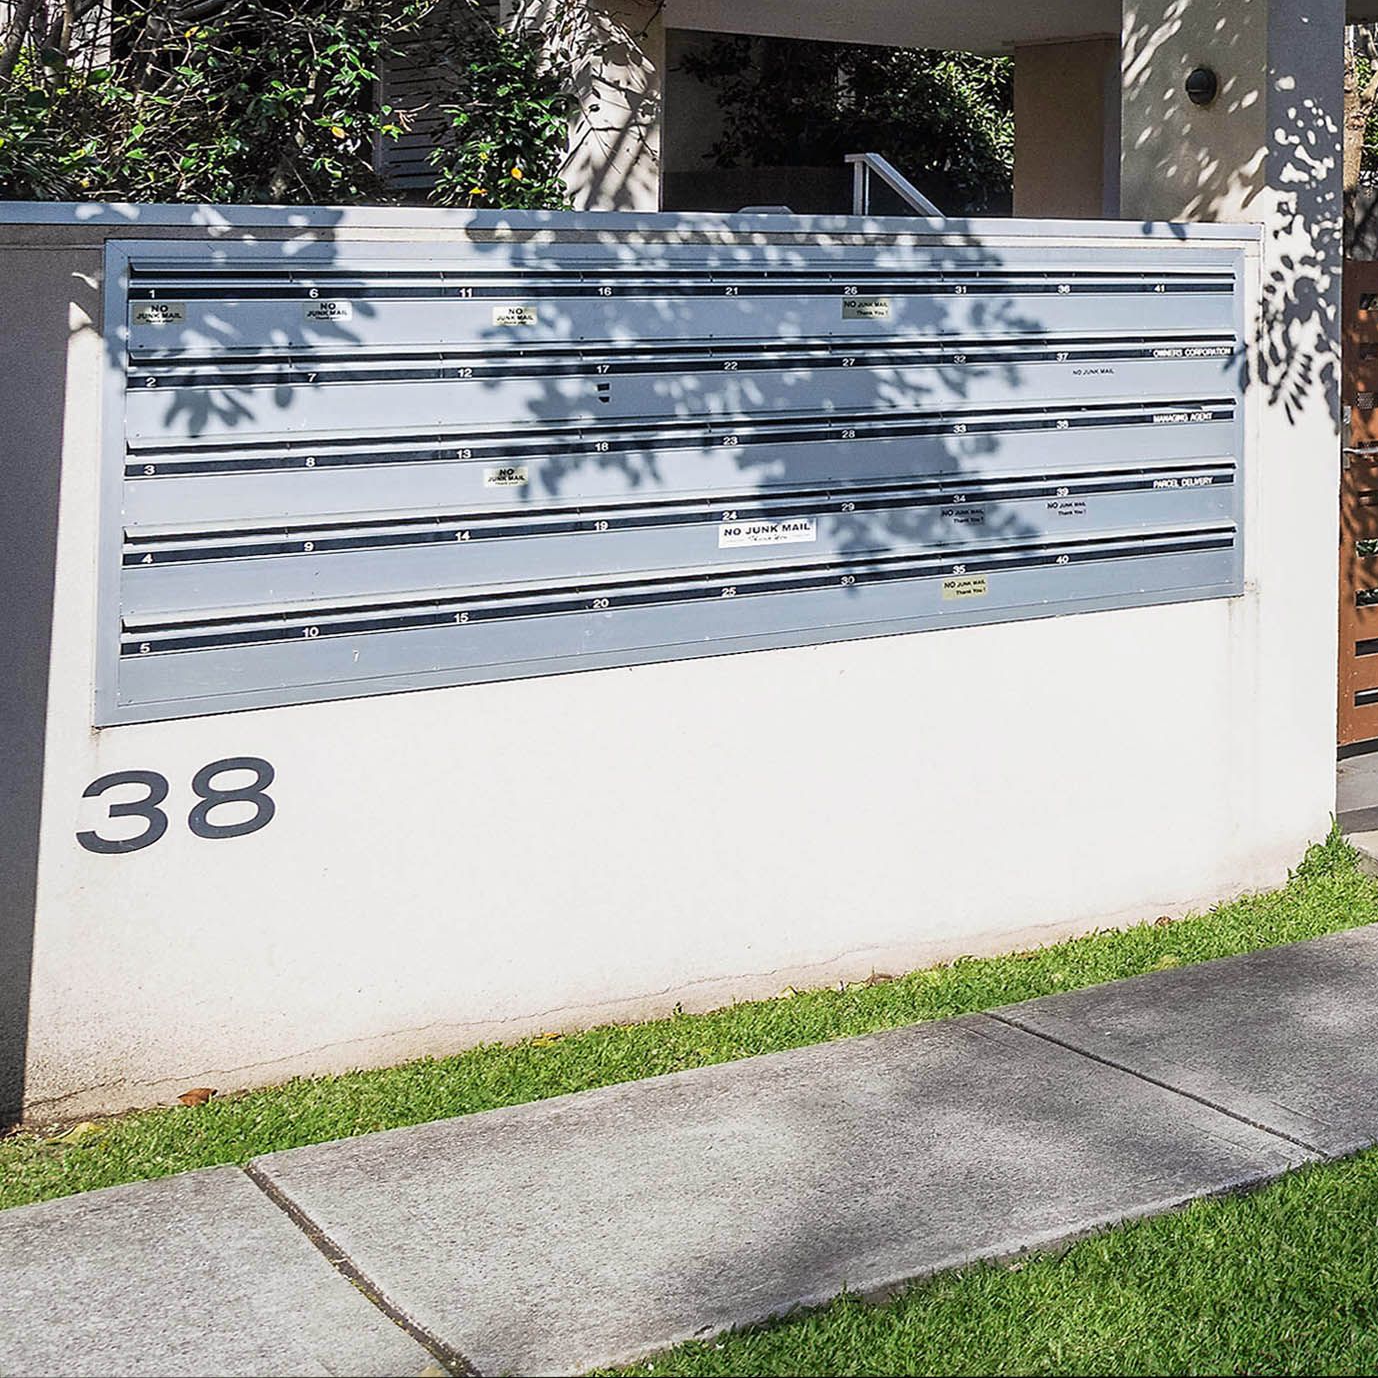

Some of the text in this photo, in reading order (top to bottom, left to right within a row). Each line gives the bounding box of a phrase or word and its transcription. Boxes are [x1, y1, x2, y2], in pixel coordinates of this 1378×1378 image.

[150, 290, 154, 298] 1
[309, 289, 318, 298] 6
[460, 288, 472, 297] 11
[599, 287, 611, 295] 16
[726, 287, 737, 295] 21
[845, 287, 857, 295] 26
[955, 286, 966, 294] 31
[724, 362, 737, 370] 22
[843, 358, 855, 366] 27
[458, 368, 472, 377] 12
[597, 365, 609, 374] 17
[308, 373, 316, 382] 7
[146, 378, 156, 387] 2
[953, 425, 967, 433] 33
[842, 430, 855, 438] 28
[724, 437, 737, 445] 23
[595, 442, 608, 451] 18
[457, 449, 471, 458] 13
[306, 457, 315, 467] 8
[144, 466, 155, 475] 3
[1056, 487, 1069, 496] 39
[953, 494, 966, 502] 34
[841, 502, 855, 511] 29
[722, 511, 737, 520] 24
[595, 521, 608, 530] 19
[724, 523, 811, 536] NO JUNK MAIL
[455, 531, 470, 540] 14
[304, 541, 314, 551] 9
[142, 554, 153, 563] 4
[1056, 555, 1069, 564] 40
[953, 564, 966, 574] 35
[841, 576, 854, 585] 30
[722, 587, 736, 596] 25
[594, 599, 609, 608] 20
[454, 613, 468, 622] 15
[303, 626, 319, 636] 10
[141, 643, 150, 652] 5
[75, 756, 276, 855] 38
